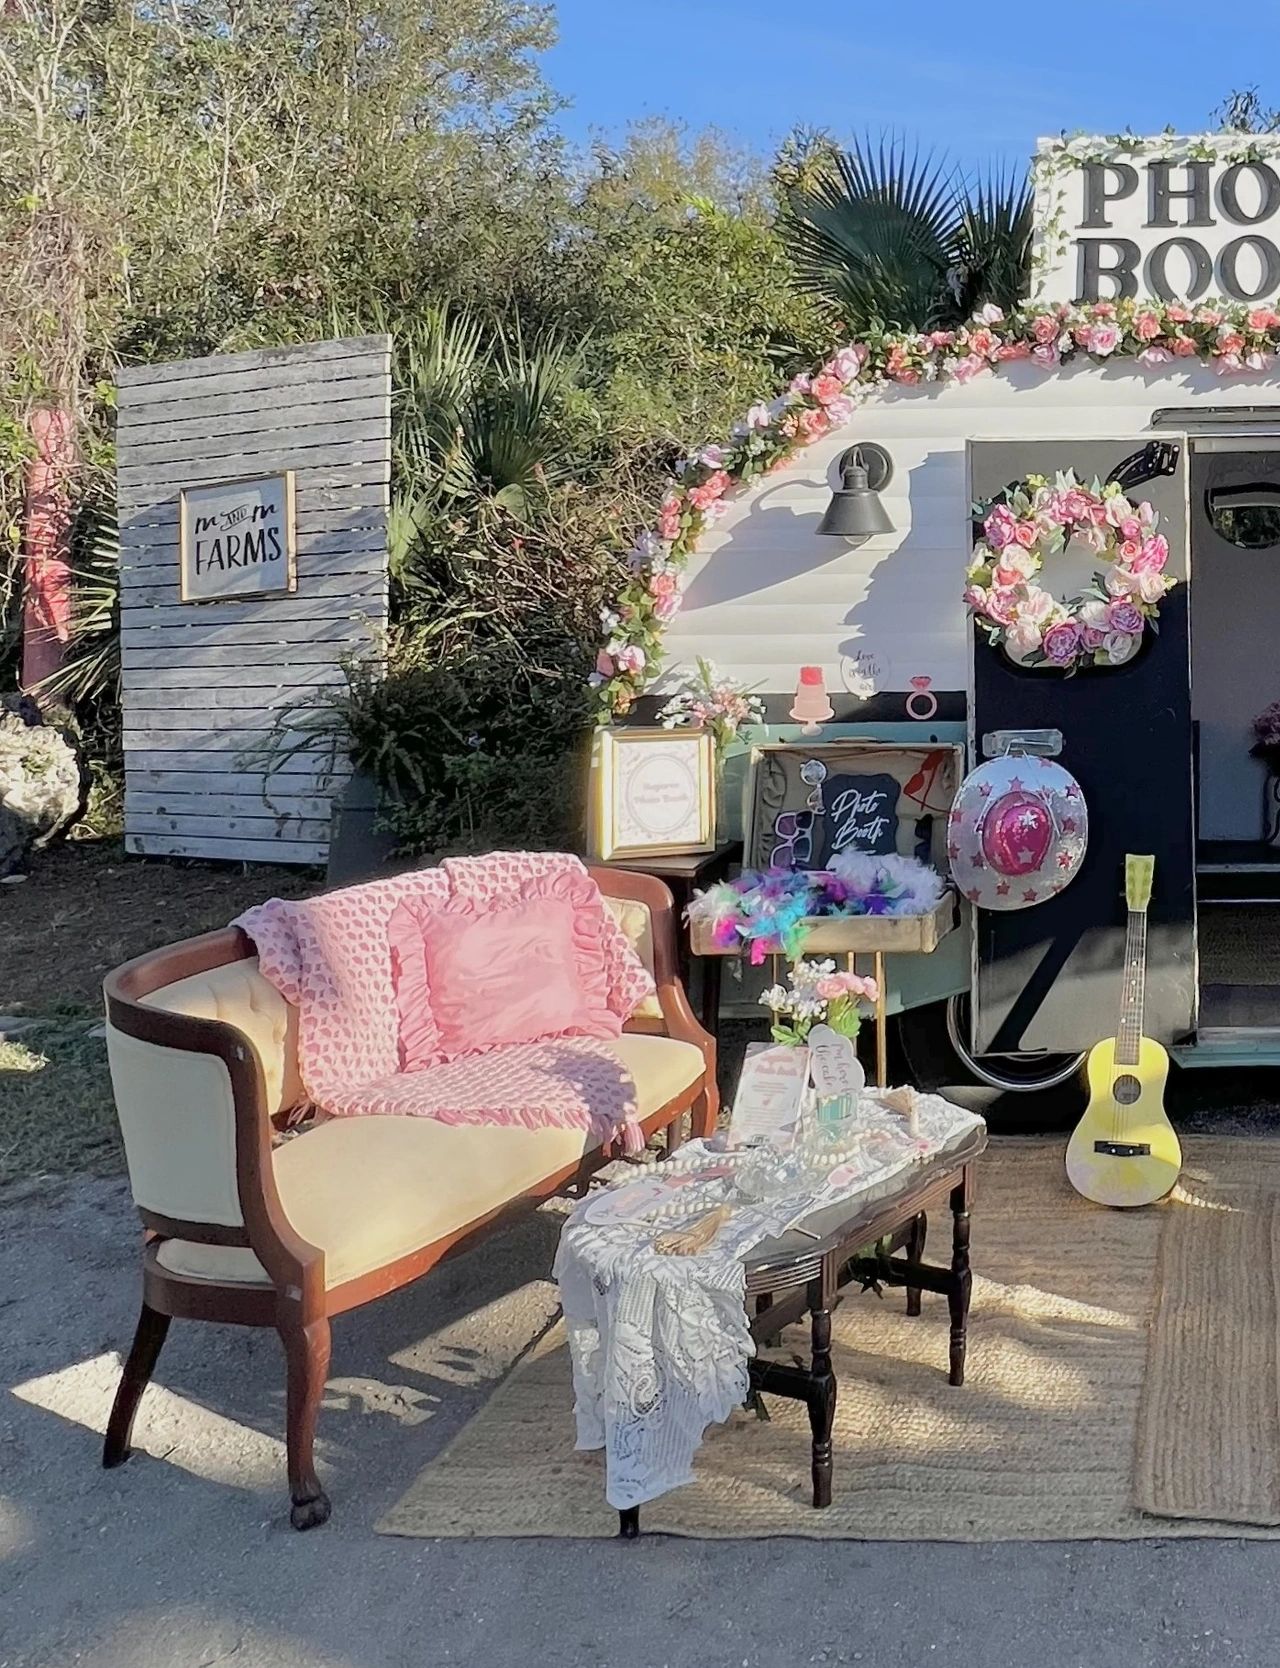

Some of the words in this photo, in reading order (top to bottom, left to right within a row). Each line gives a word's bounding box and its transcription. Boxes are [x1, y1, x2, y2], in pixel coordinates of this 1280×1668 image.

[221, 506, 250, 529] AND
[195, 526, 283, 576] FARMS
[830, 788, 888, 823] Photo
[830, 817, 890, 850] Booth
